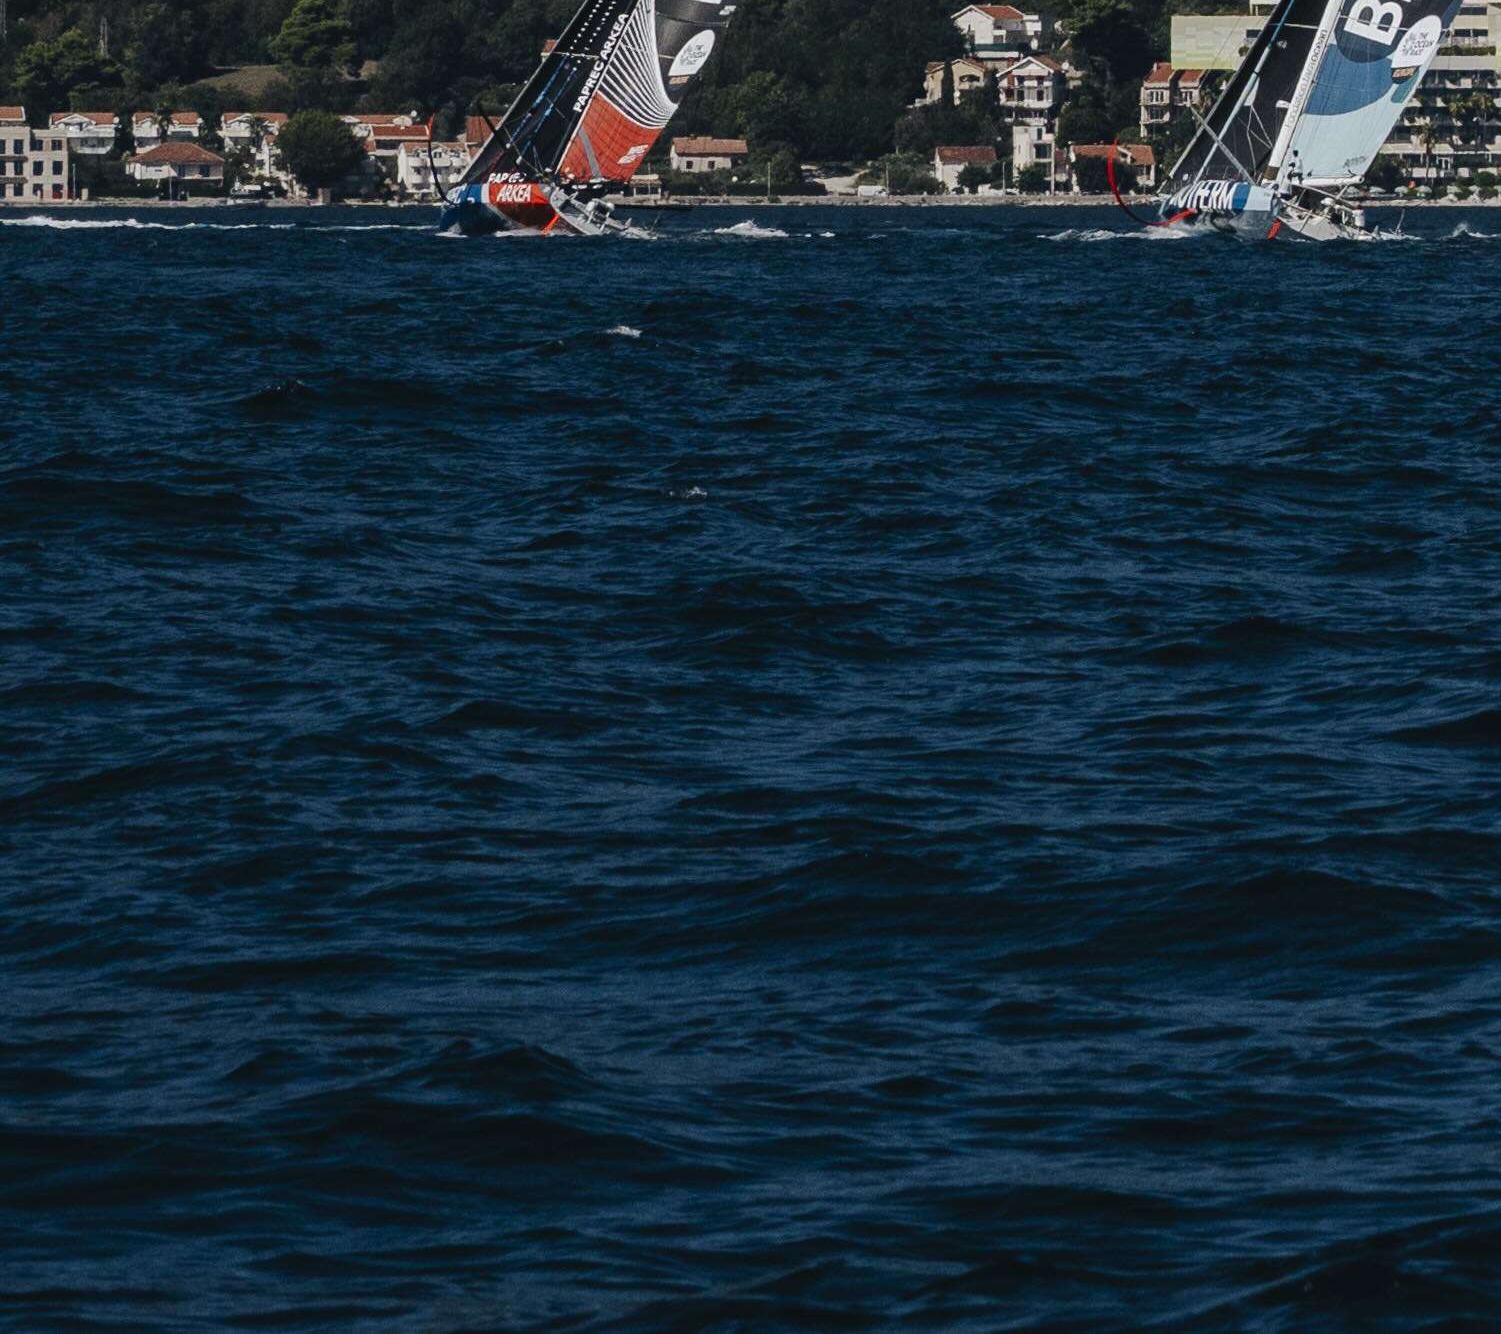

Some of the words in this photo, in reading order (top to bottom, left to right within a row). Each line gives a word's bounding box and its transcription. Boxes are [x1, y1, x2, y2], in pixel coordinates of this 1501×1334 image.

[573, 60, 605, 113] PAPREC
[600, 13, 629, 61] ARKEA
[496, 184, 532, 202] ARKEA
